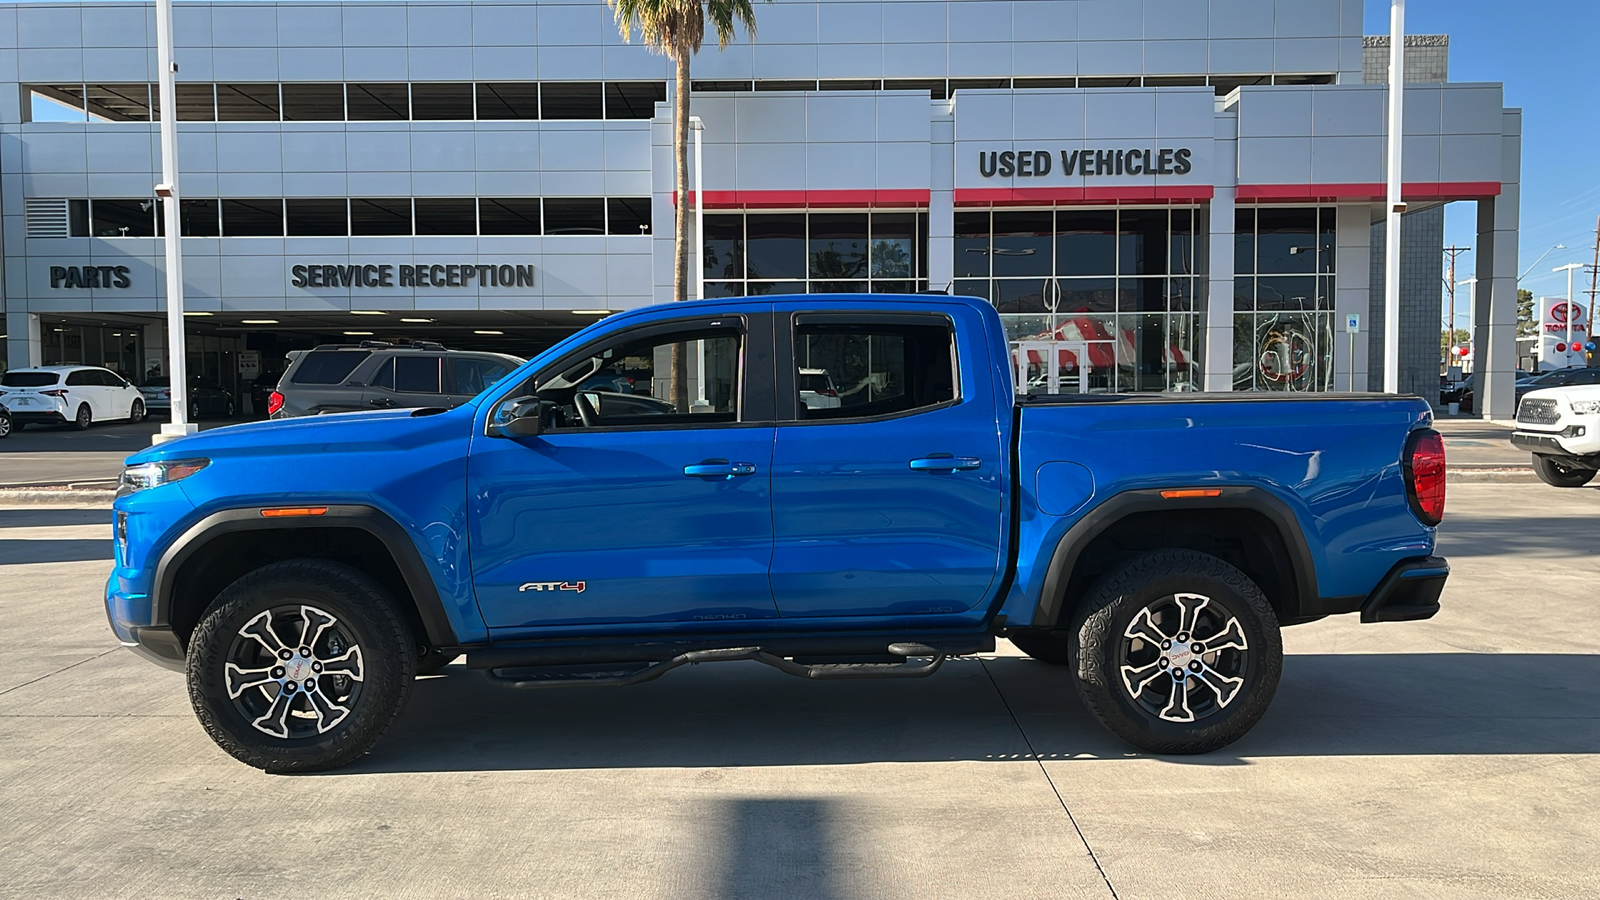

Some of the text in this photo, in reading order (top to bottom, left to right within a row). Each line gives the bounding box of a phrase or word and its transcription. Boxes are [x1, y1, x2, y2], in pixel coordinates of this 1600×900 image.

[979, 148, 1192, 177] USED VEHICLES
[49, 265, 131, 288] PARTS
[291, 264, 534, 288] SERVICE RECEPTION
[1545, 323, 1586, 332] TOYTA
[518, 581, 586, 593] AT4
[294, 660, 304, 679] GMC
